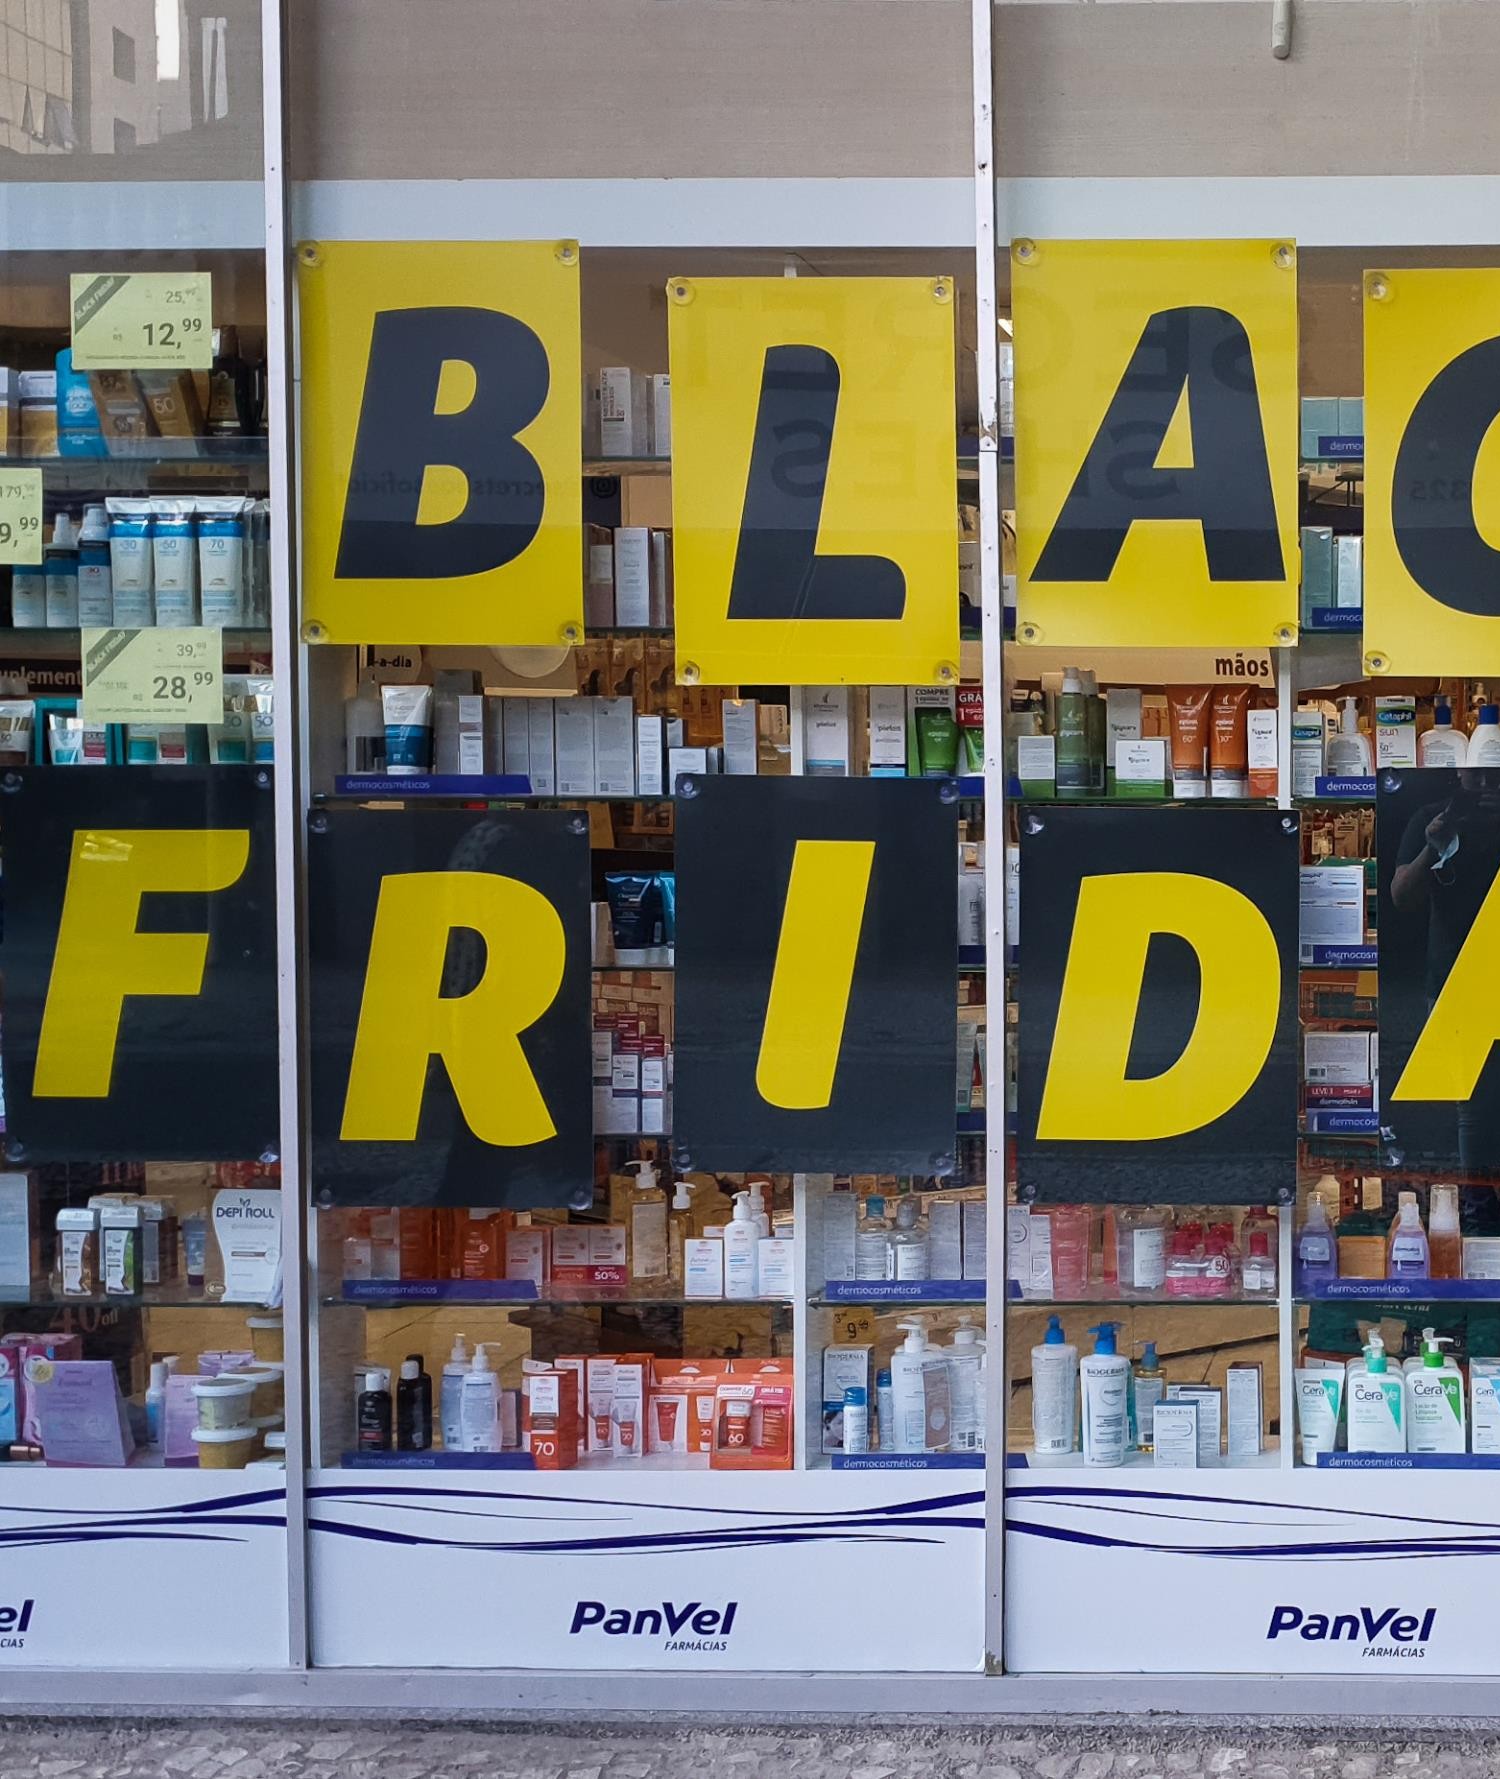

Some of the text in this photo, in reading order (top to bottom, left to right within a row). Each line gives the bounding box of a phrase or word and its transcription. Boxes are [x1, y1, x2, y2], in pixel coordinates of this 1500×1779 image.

[1215, 654, 1270, 677] mãos
[1378, 711, 1412, 721] Cetaphil
[216, 1207, 275, 1218] DEPI ROLL
[837, 1284, 922, 1295] dermocosméticos
[1355, 1387, 1399, 1400] CeraVe
[1414, 1384, 1458, 1395] CeraVe
[728, 1434, 744, 1444] 60
[534, 1442, 555, 1456] 70
[844, 1458, 927, 1468] dermocosméticos
[570, 1601, 738, 1637] PanVel
[1266, 1606, 1437, 1642] PanVel
[664, 1640, 727, 1651] FARMÁCIAS
[1362, 1646, 1425, 1657] FARMÁCIAS
